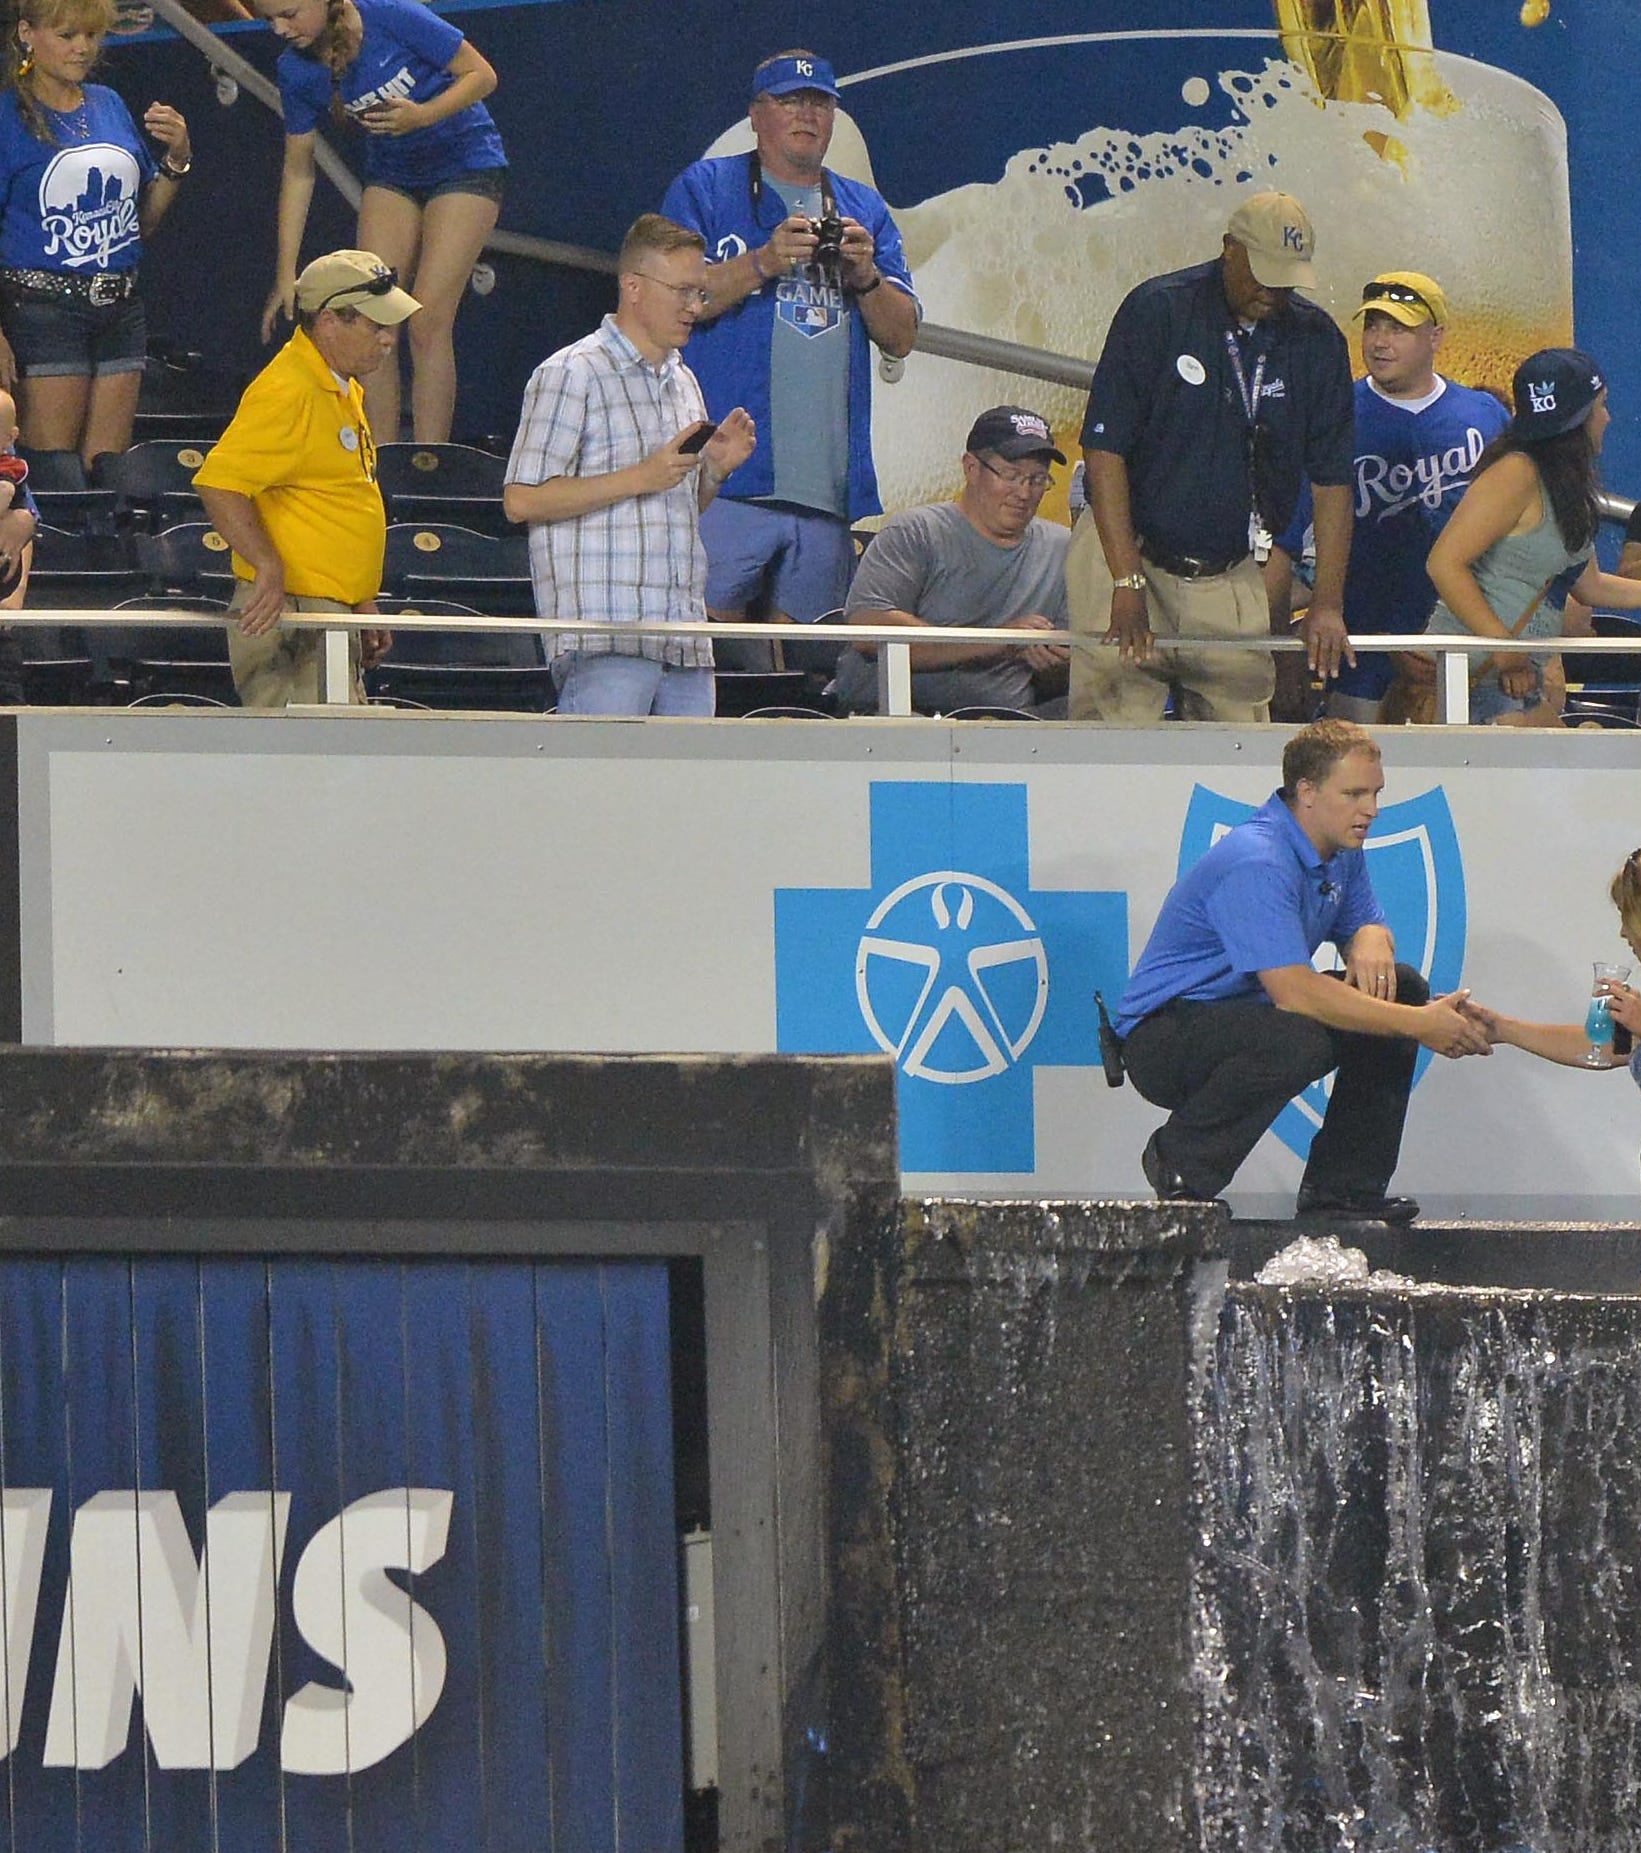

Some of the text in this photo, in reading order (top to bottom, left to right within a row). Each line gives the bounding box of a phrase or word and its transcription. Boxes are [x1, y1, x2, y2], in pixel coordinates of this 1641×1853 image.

[796, 60, 813, 77] KC
[41, 198, 140, 268] Royals
[1283, 225, 1304, 252] KC
[1353, 427, 1485, 518] Royal
